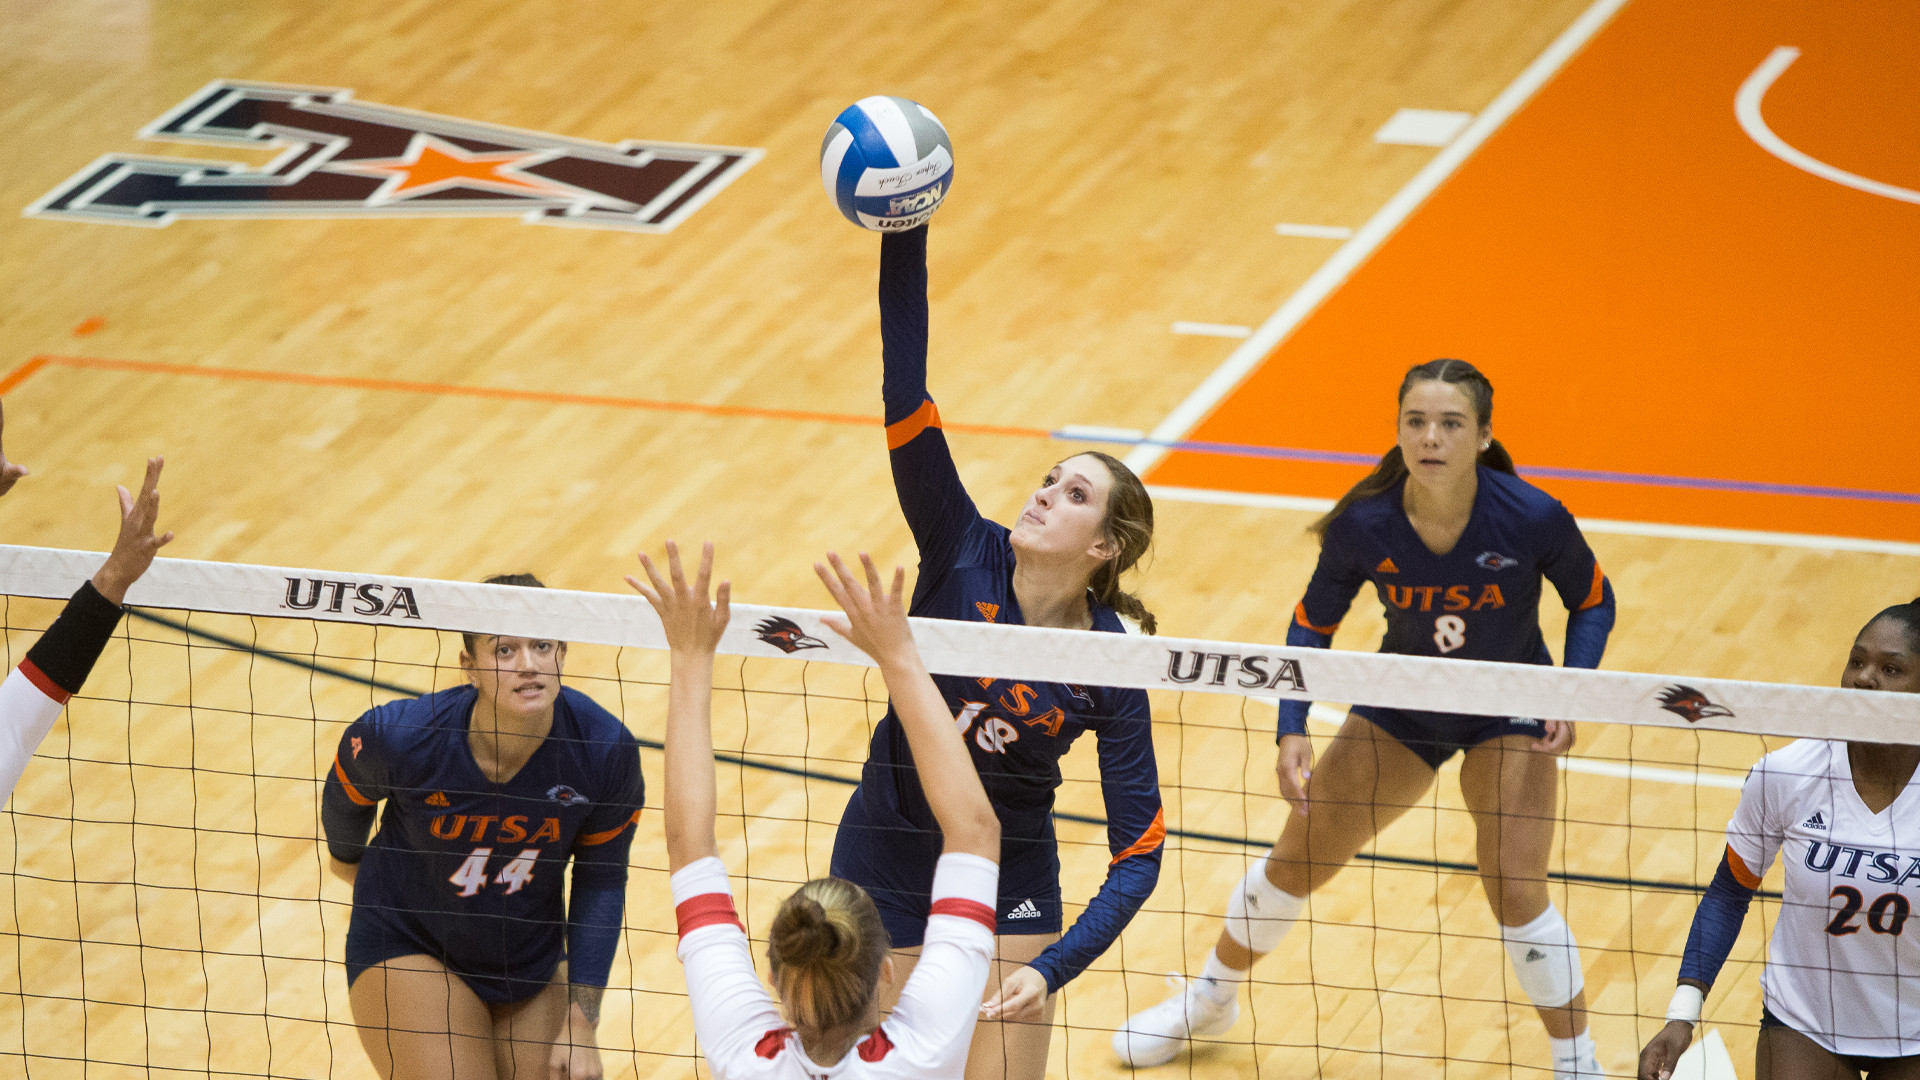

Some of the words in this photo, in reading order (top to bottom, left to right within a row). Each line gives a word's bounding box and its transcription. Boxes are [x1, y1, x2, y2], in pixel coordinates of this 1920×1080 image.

[878, 172, 913, 190] Touch
[916, 160, 942, 177] Super
[889, 180, 943, 216] NCAA
[284, 576, 422, 620] UTSA
[1385, 583, 1506, 612] UTSA
[1433, 614, 1467, 654] 8
[1167, 649, 1308, 692] UTSA
[954, 697, 1020, 755] 18
[976, 676, 1066, 737] SA
[429, 813, 561, 844] UTSA
[448, 847, 541, 897] 44
[1804, 839, 1920, 888] UTSA
[1007, 910, 1042, 920] adidas
[1824, 885, 1911, 938] 20
